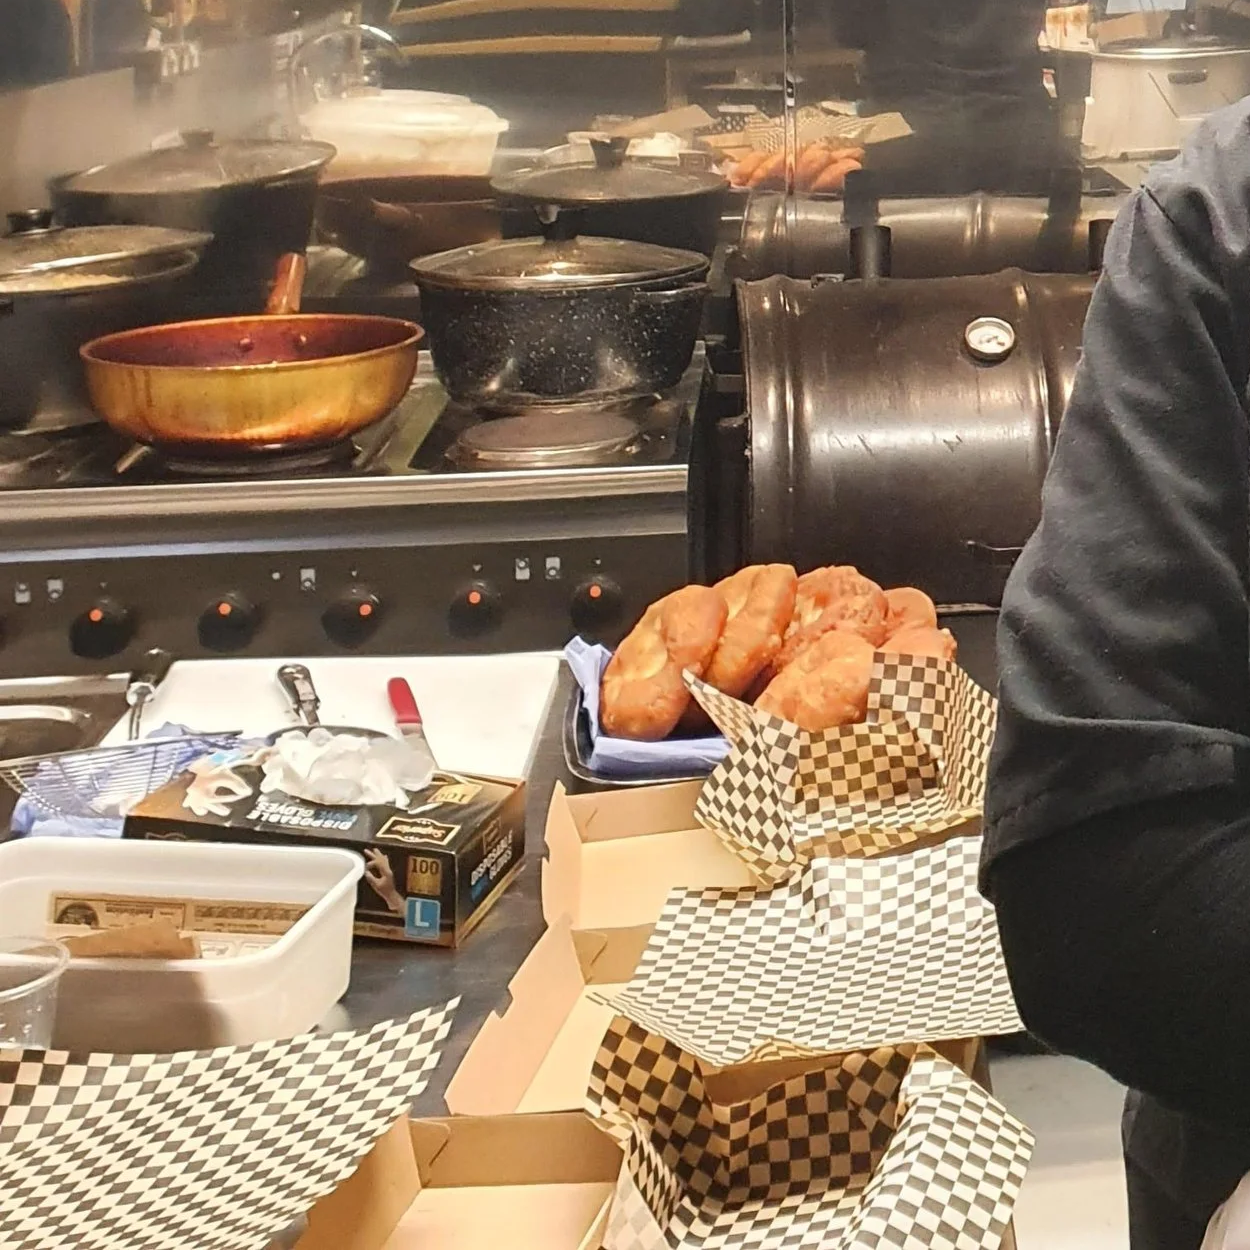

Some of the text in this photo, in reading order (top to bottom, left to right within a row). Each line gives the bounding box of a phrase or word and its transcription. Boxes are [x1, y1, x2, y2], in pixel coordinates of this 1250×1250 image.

[246, 809, 353, 831] DISPOSABLE
[411, 858, 439, 875] 100
[415, 901, 429, 928] L
